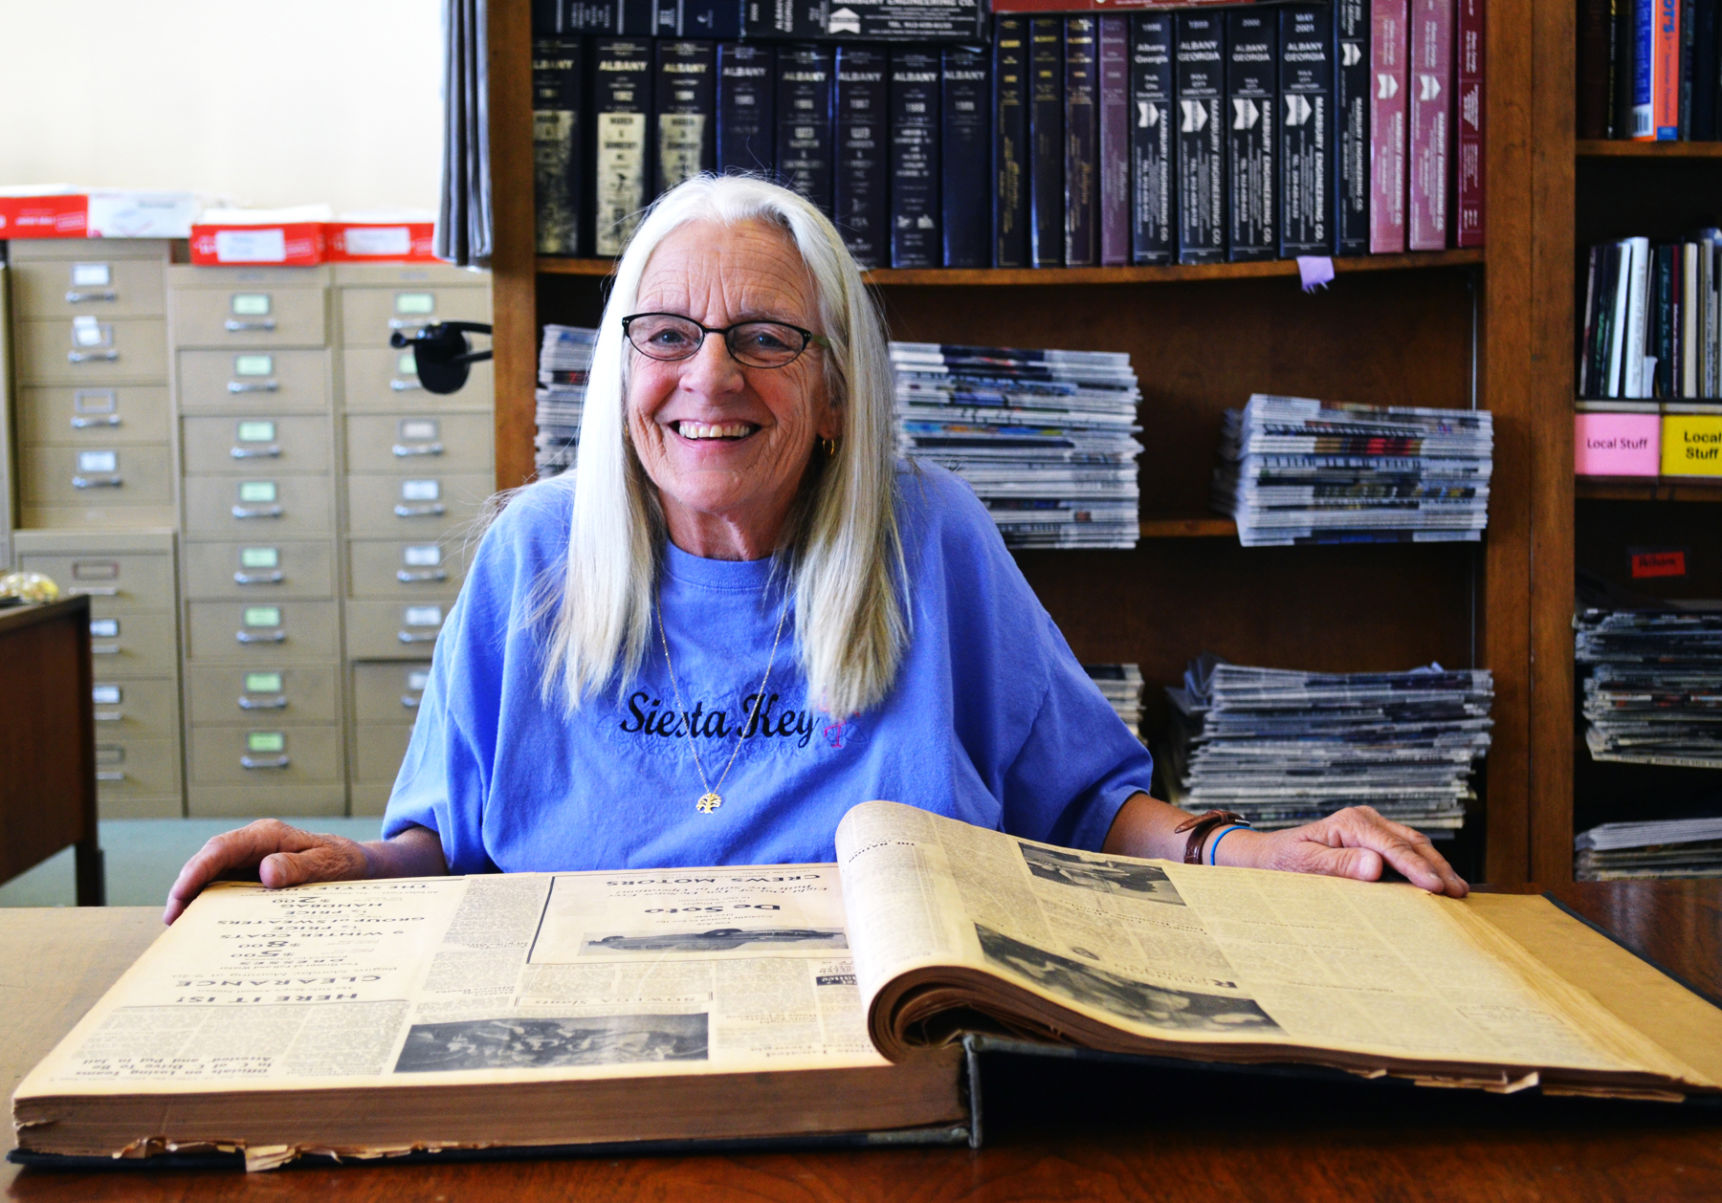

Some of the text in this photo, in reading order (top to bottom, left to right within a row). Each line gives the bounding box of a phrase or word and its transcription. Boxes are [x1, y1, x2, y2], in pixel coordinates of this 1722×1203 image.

[1180, 41, 1218, 50] ALBANY
[1235, 44, 1268, 52] ALBANY
[1287, 42, 1323, 51] ALBANY
[1177, 52, 1221, 62] GEORGIA
[1232, 53, 1271, 62] GEORGIA
[1284, 52, 1326, 62] GEORGIA
[533, 60, 574, 70] LBANY
[782, 72, 826, 81] ALBANY
[838, 72, 882, 81] ALBANY
[893, 72, 938, 82] ALBANY
[943, 71, 986, 80] ALBANY
[1158, 160, 1168, 225] ENGINEERING
[1210, 154, 1220, 226] ENGINEERING
[1262, 155, 1271, 226] ENGINEERING
[1315, 152, 1324, 223] ENGINEERING
[1684, 431, 1722, 443] Local
[1587, 437, 1648, 450] Local Stuff
[1686, 448, 1719, 460] Stuff
[620, 692, 820, 748] Siesta Key
[606, 875, 821, 886] CREWS MOTORS
[644, 906, 724, 914] Soto
[175, 975, 381, 987] CLEARANCE
[275, 993, 358, 1002] HERE
